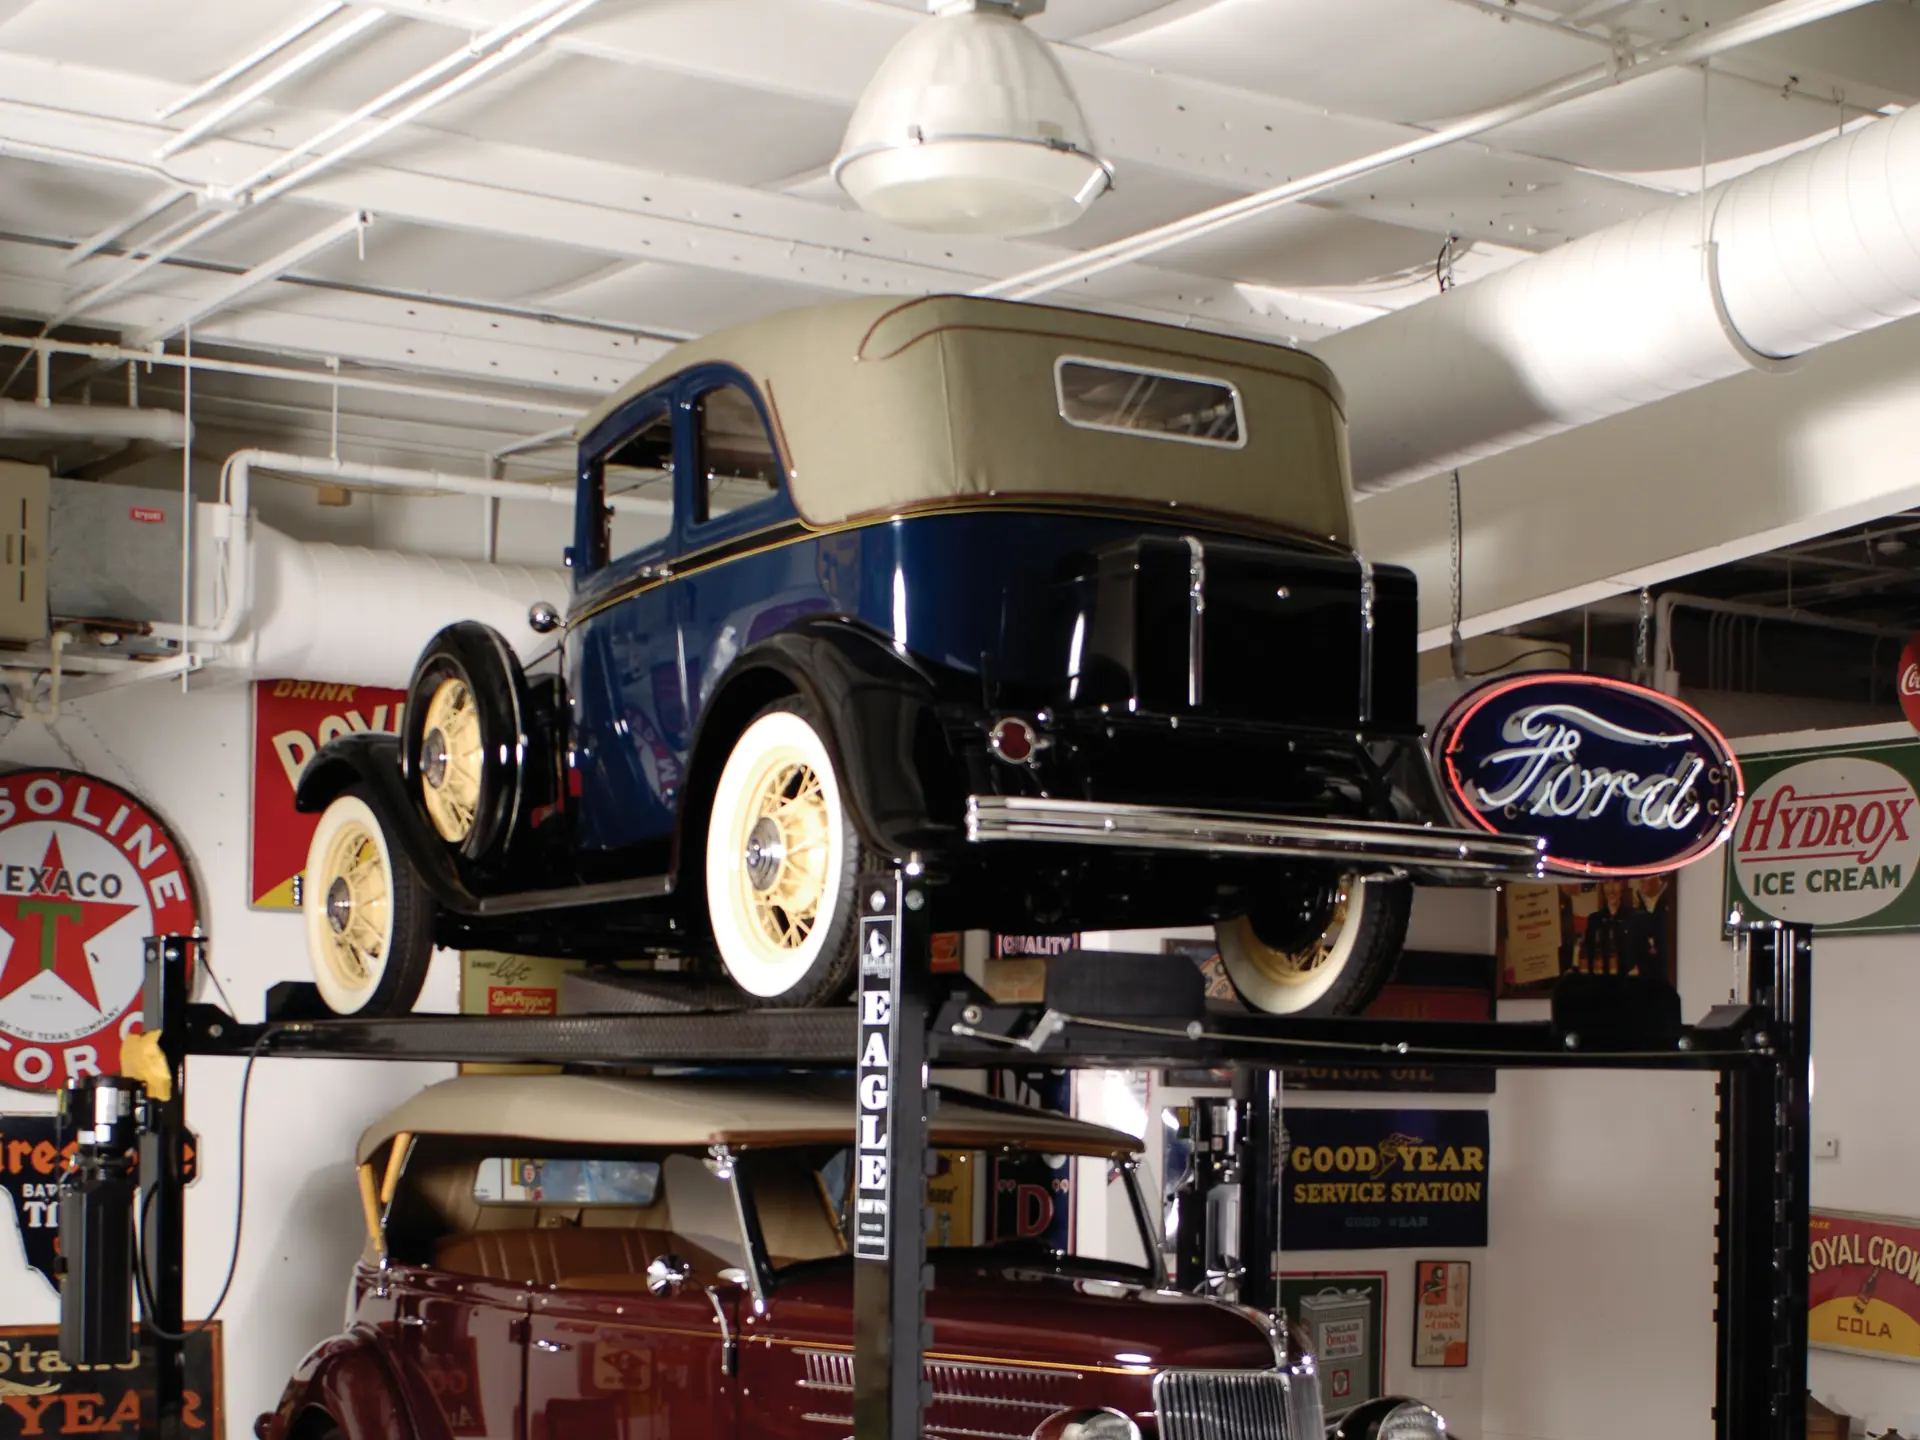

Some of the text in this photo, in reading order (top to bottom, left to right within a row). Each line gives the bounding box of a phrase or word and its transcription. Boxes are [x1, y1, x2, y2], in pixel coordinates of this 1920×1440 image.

[272, 679, 357, 703] DRINK
[1468, 703, 1705, 831] Ford
[1737, 786, 1914, 862] HYDROX
[1753, 864, 1901, 897] ICE CREAM
[38, 1031, 71, 1041] TEXAS
[74, 1007, 120, 1037] COMPANY
[859, 990, 891, 1190] EAGLE
[1292, 1146, 1485, 1172] GOOD YEAR
[1294, 1182, 1481, 1203] SERVICE STATION
[1836, 1315, 1892, 1339] COLA
